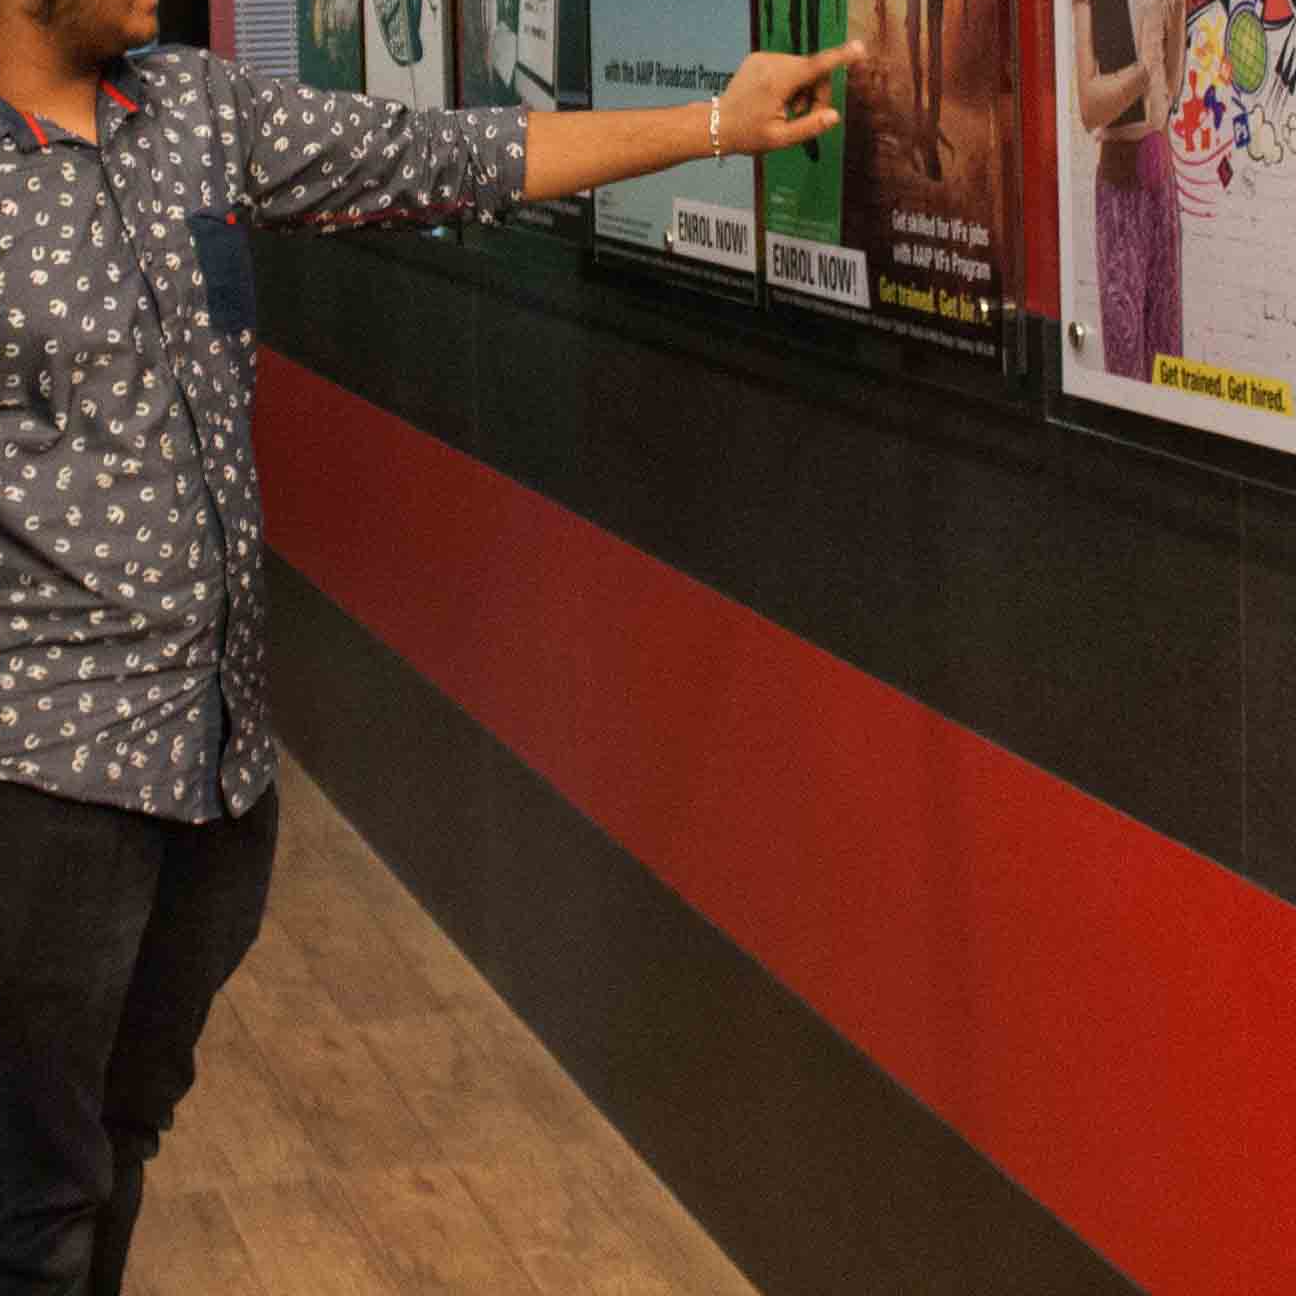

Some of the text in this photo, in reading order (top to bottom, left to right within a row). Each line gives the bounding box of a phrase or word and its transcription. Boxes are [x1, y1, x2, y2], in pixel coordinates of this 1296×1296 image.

[678, 211, 713, 248] ENROL
[715, 216, 748, 256] NOW!
[772, 243, 815, 286] ENROL
[818, 253, 856, 296] NOW!
[1159, 360, 1287, 413] Get trained. Get hired.
